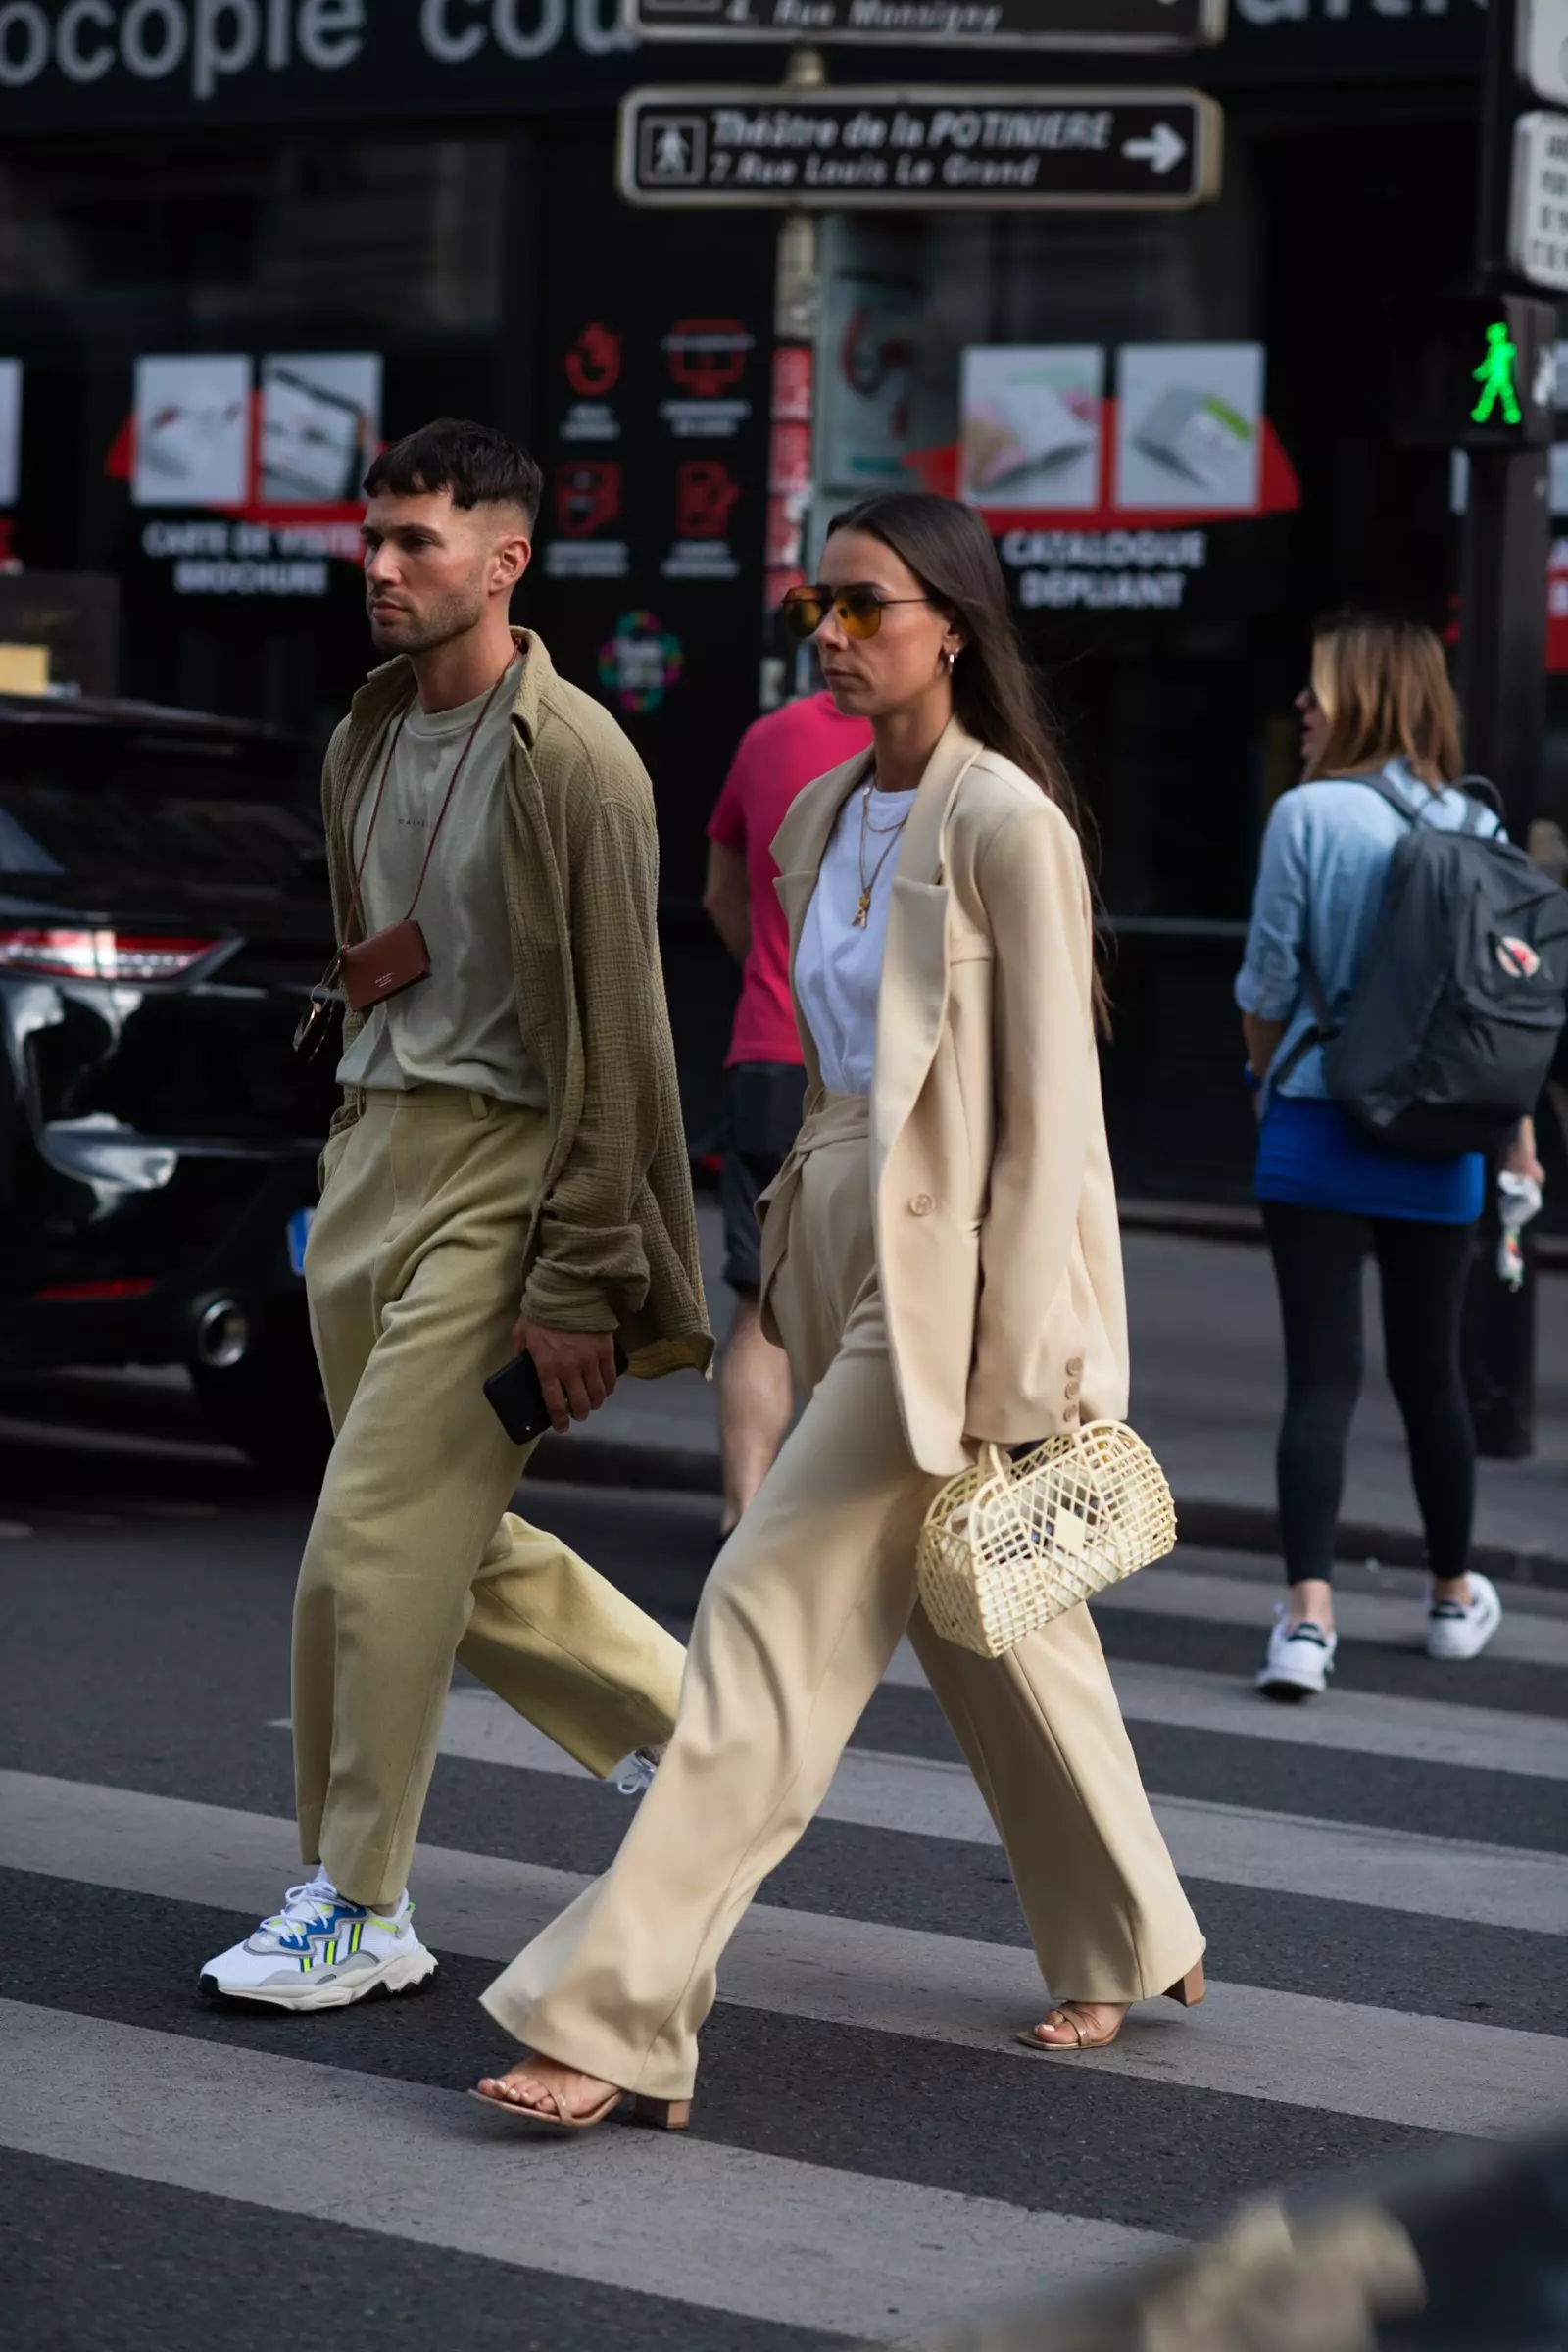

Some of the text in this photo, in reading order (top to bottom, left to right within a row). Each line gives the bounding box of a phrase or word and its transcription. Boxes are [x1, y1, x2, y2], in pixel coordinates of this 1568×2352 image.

[711, 109, 839, 148] Théâtre
[842, 110, 887, 148] de
[890, 110, 924, 148] la
[736, 152, 798, 185] Rue
[802, 153, 888, 186] Louis
[894, 153, 934, 186] Le
[941, 153, 1039, 186] Grand
[1002, 529, 1206, 569] CATALOGUE
